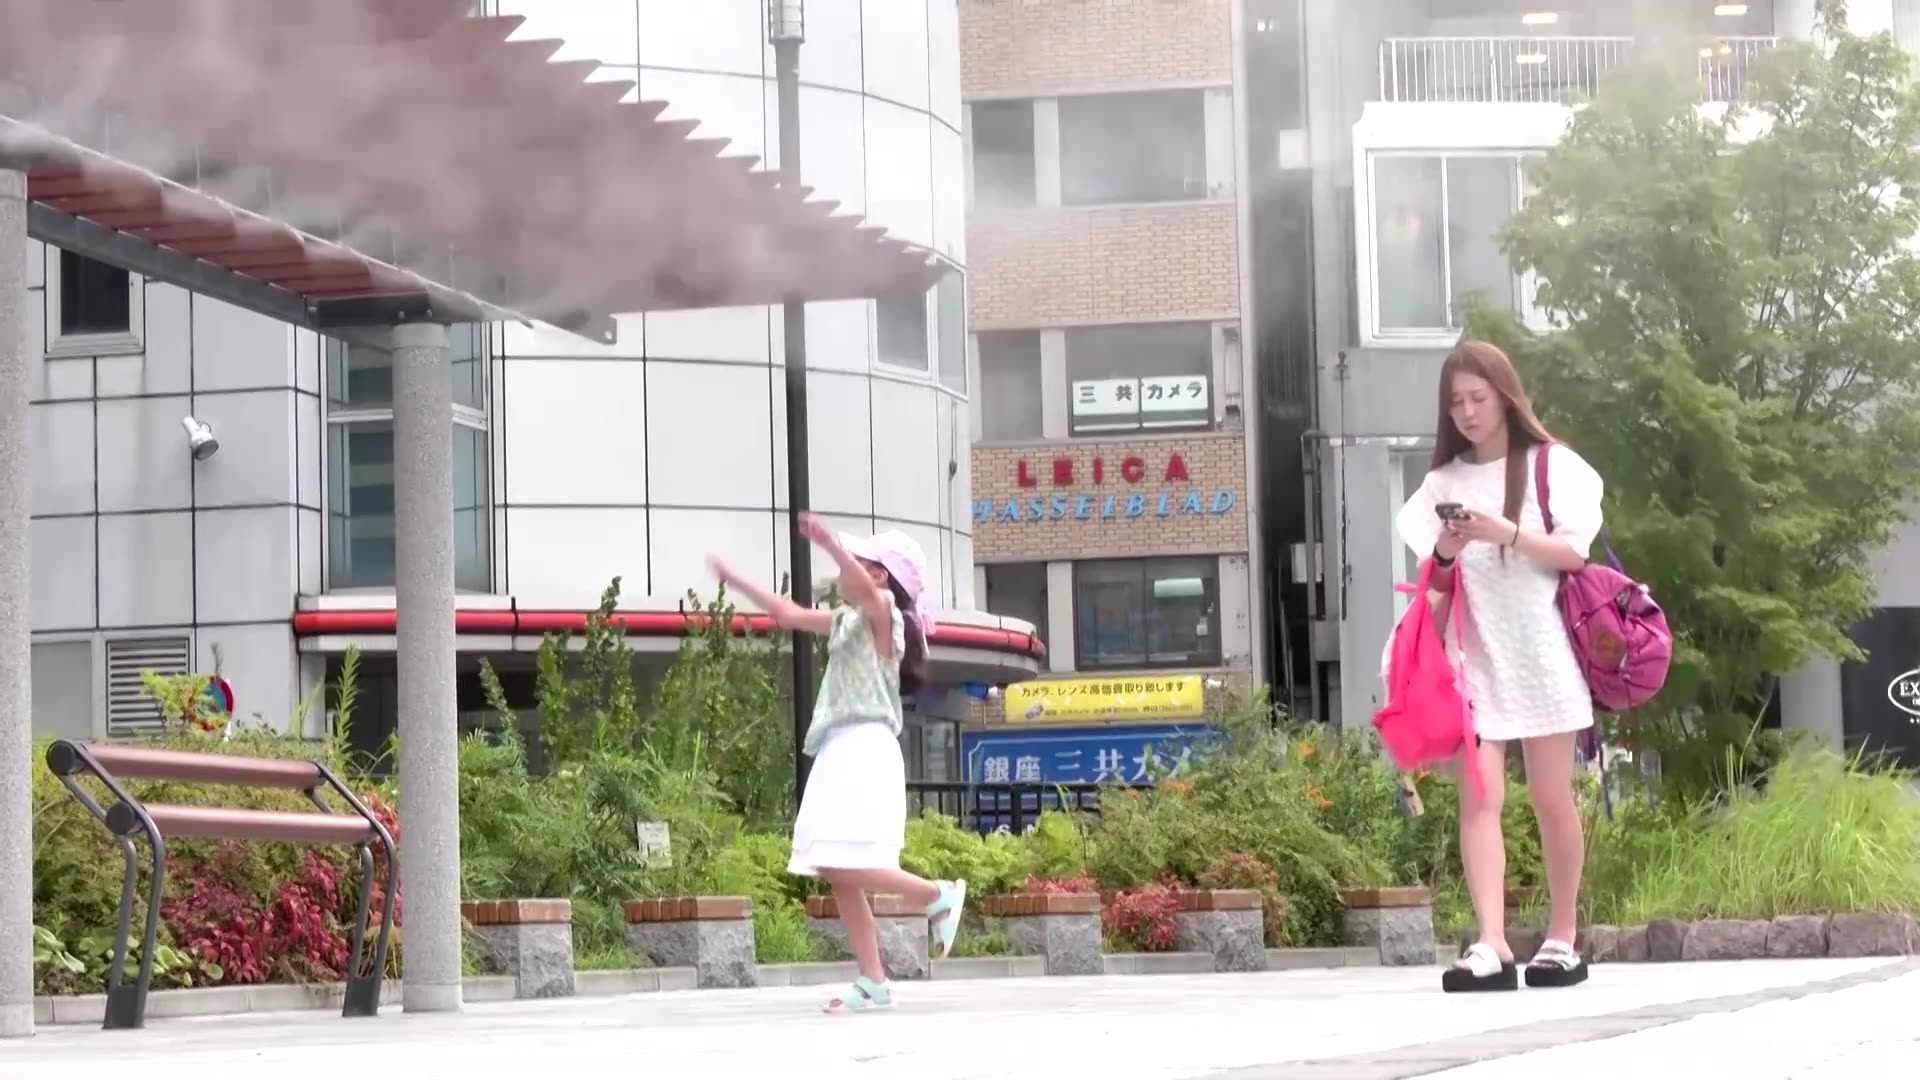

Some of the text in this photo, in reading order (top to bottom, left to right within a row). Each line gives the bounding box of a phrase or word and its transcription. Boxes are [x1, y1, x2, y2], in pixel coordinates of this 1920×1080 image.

[1017, 452, 1188, 487] LEICA
[972, 491, 1234, 522] HASSELBLAD
[984, 755, 1041, 783] 銀座
